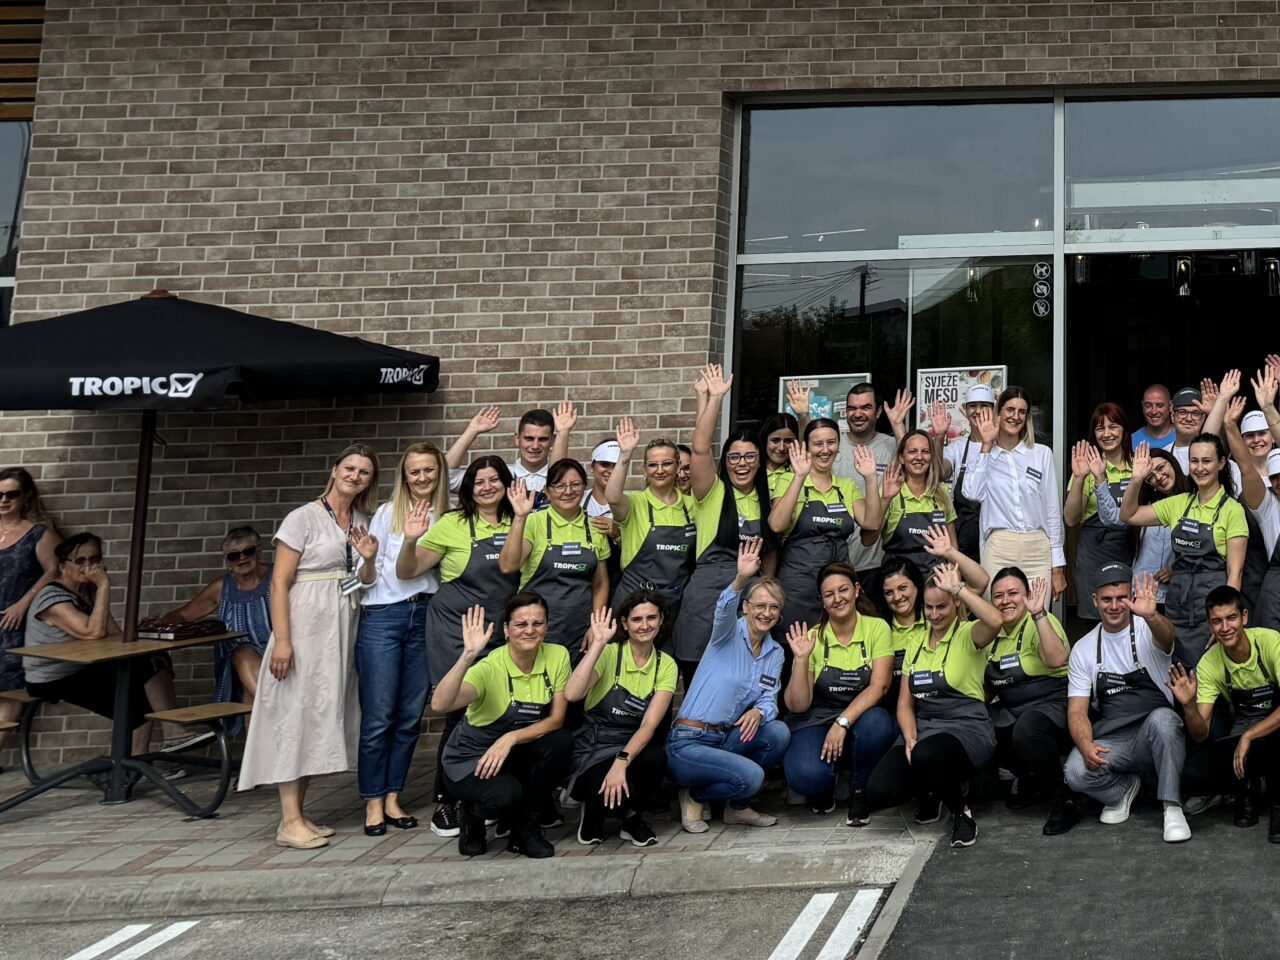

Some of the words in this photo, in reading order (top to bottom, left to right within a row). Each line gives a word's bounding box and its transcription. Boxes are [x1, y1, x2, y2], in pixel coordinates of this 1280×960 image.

[379, 367, 412, 383] TROP
[925, 372, 958, 388] SVJEŽE
[68, 376, 168, 396] TROPIC
[924, 387, 958, 404] MESO
[812, 516, 836, 524] TROPIC
[908, 527, 930, 535] TROPI
[656, 543, 681, 551] TROPIC
[1175, 538, 1195, 547] TROPIC
[553, 562, 579, 570] TROPIC
